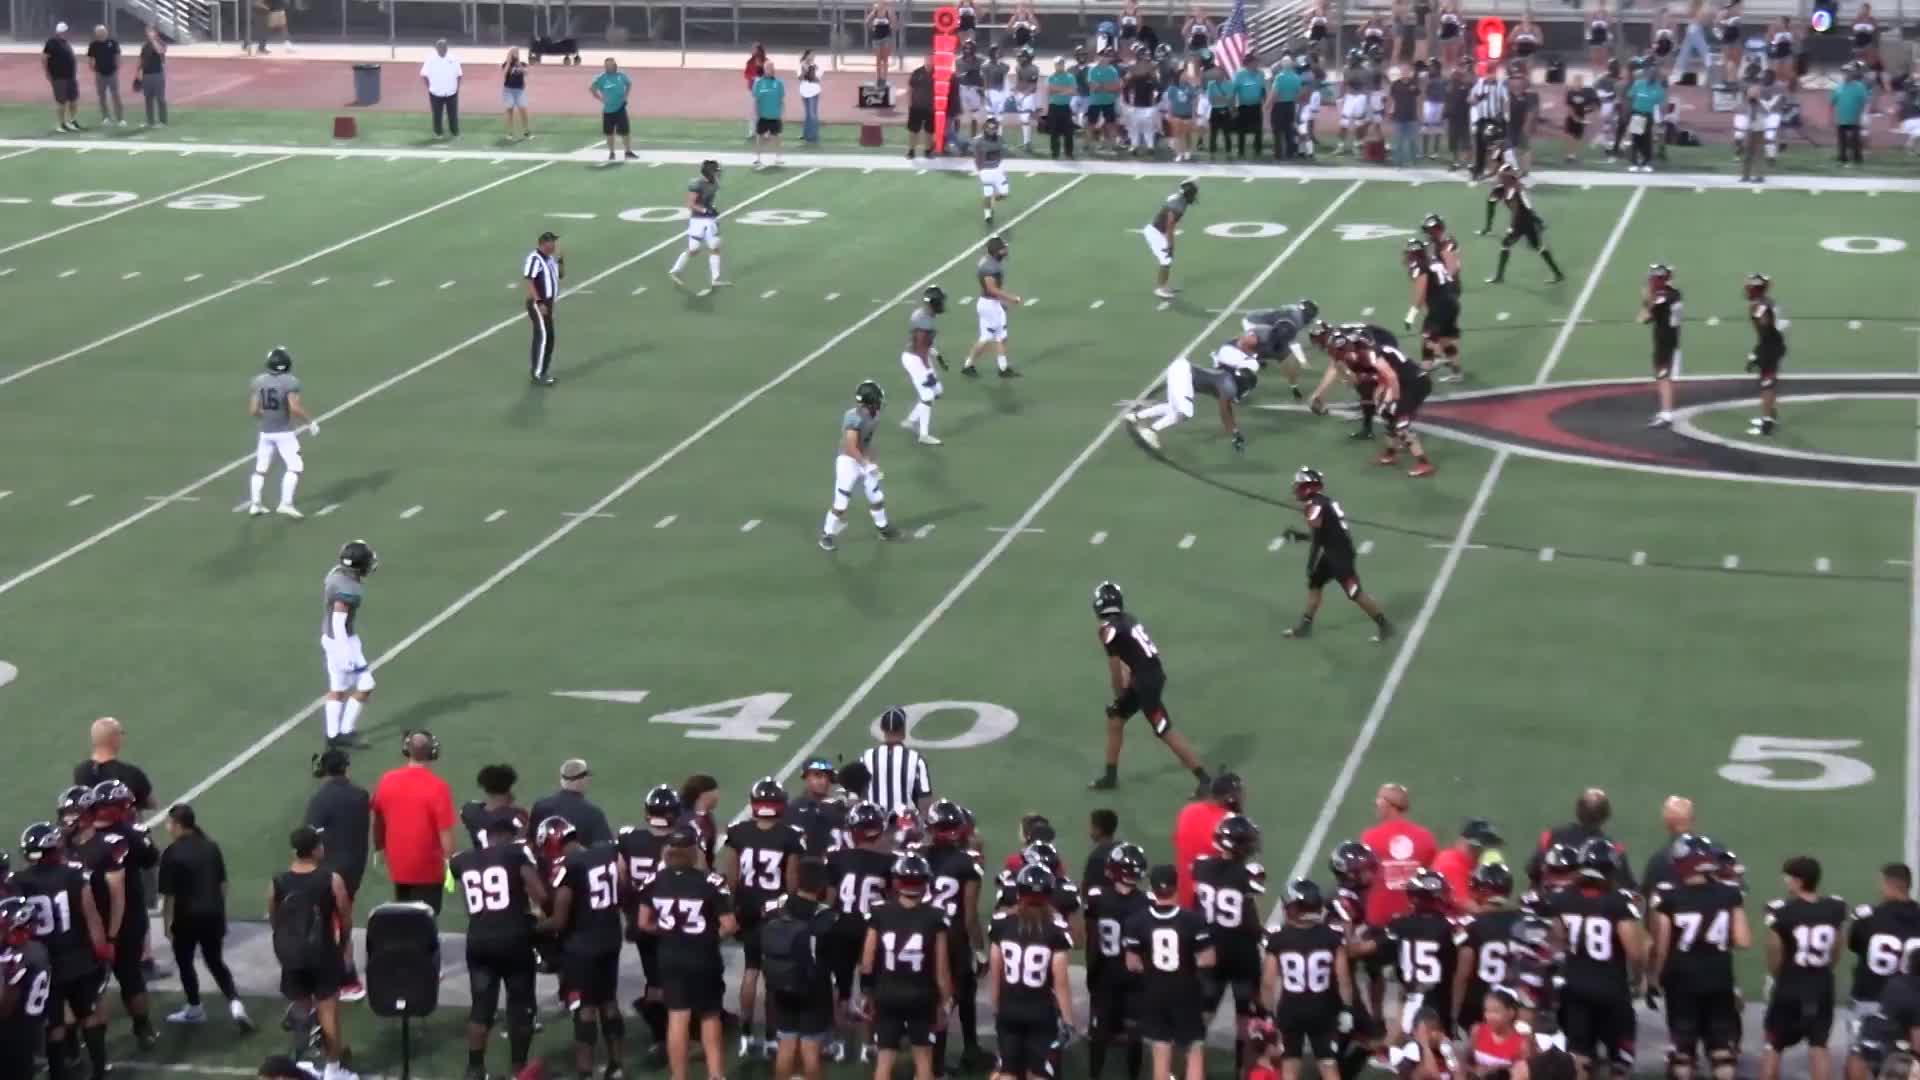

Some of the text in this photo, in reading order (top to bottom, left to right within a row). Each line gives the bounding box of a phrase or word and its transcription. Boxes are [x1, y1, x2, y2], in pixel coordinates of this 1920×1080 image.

[648, 692, 1020, 749] 40
[1717, 735, 1876, 791] 5
[462, 866, 510, 914] 69
[588, 861, 618, 910] 51
[740, 847, 785, 890] 43
[652, 897, 706, 934] 33
[1562, 913, 1613, 961] 78
[1673, 911, 1730, 951] 74
[882, 932, 925, 972] 14
[1000, 940, 1051, 988] 88
[1152, 928, 1180, 972] 8
[1400, 941, 1442, 984] 15
[1792, 924, 1836, 968] 19
[1279, 951, 1333, 993] 86
